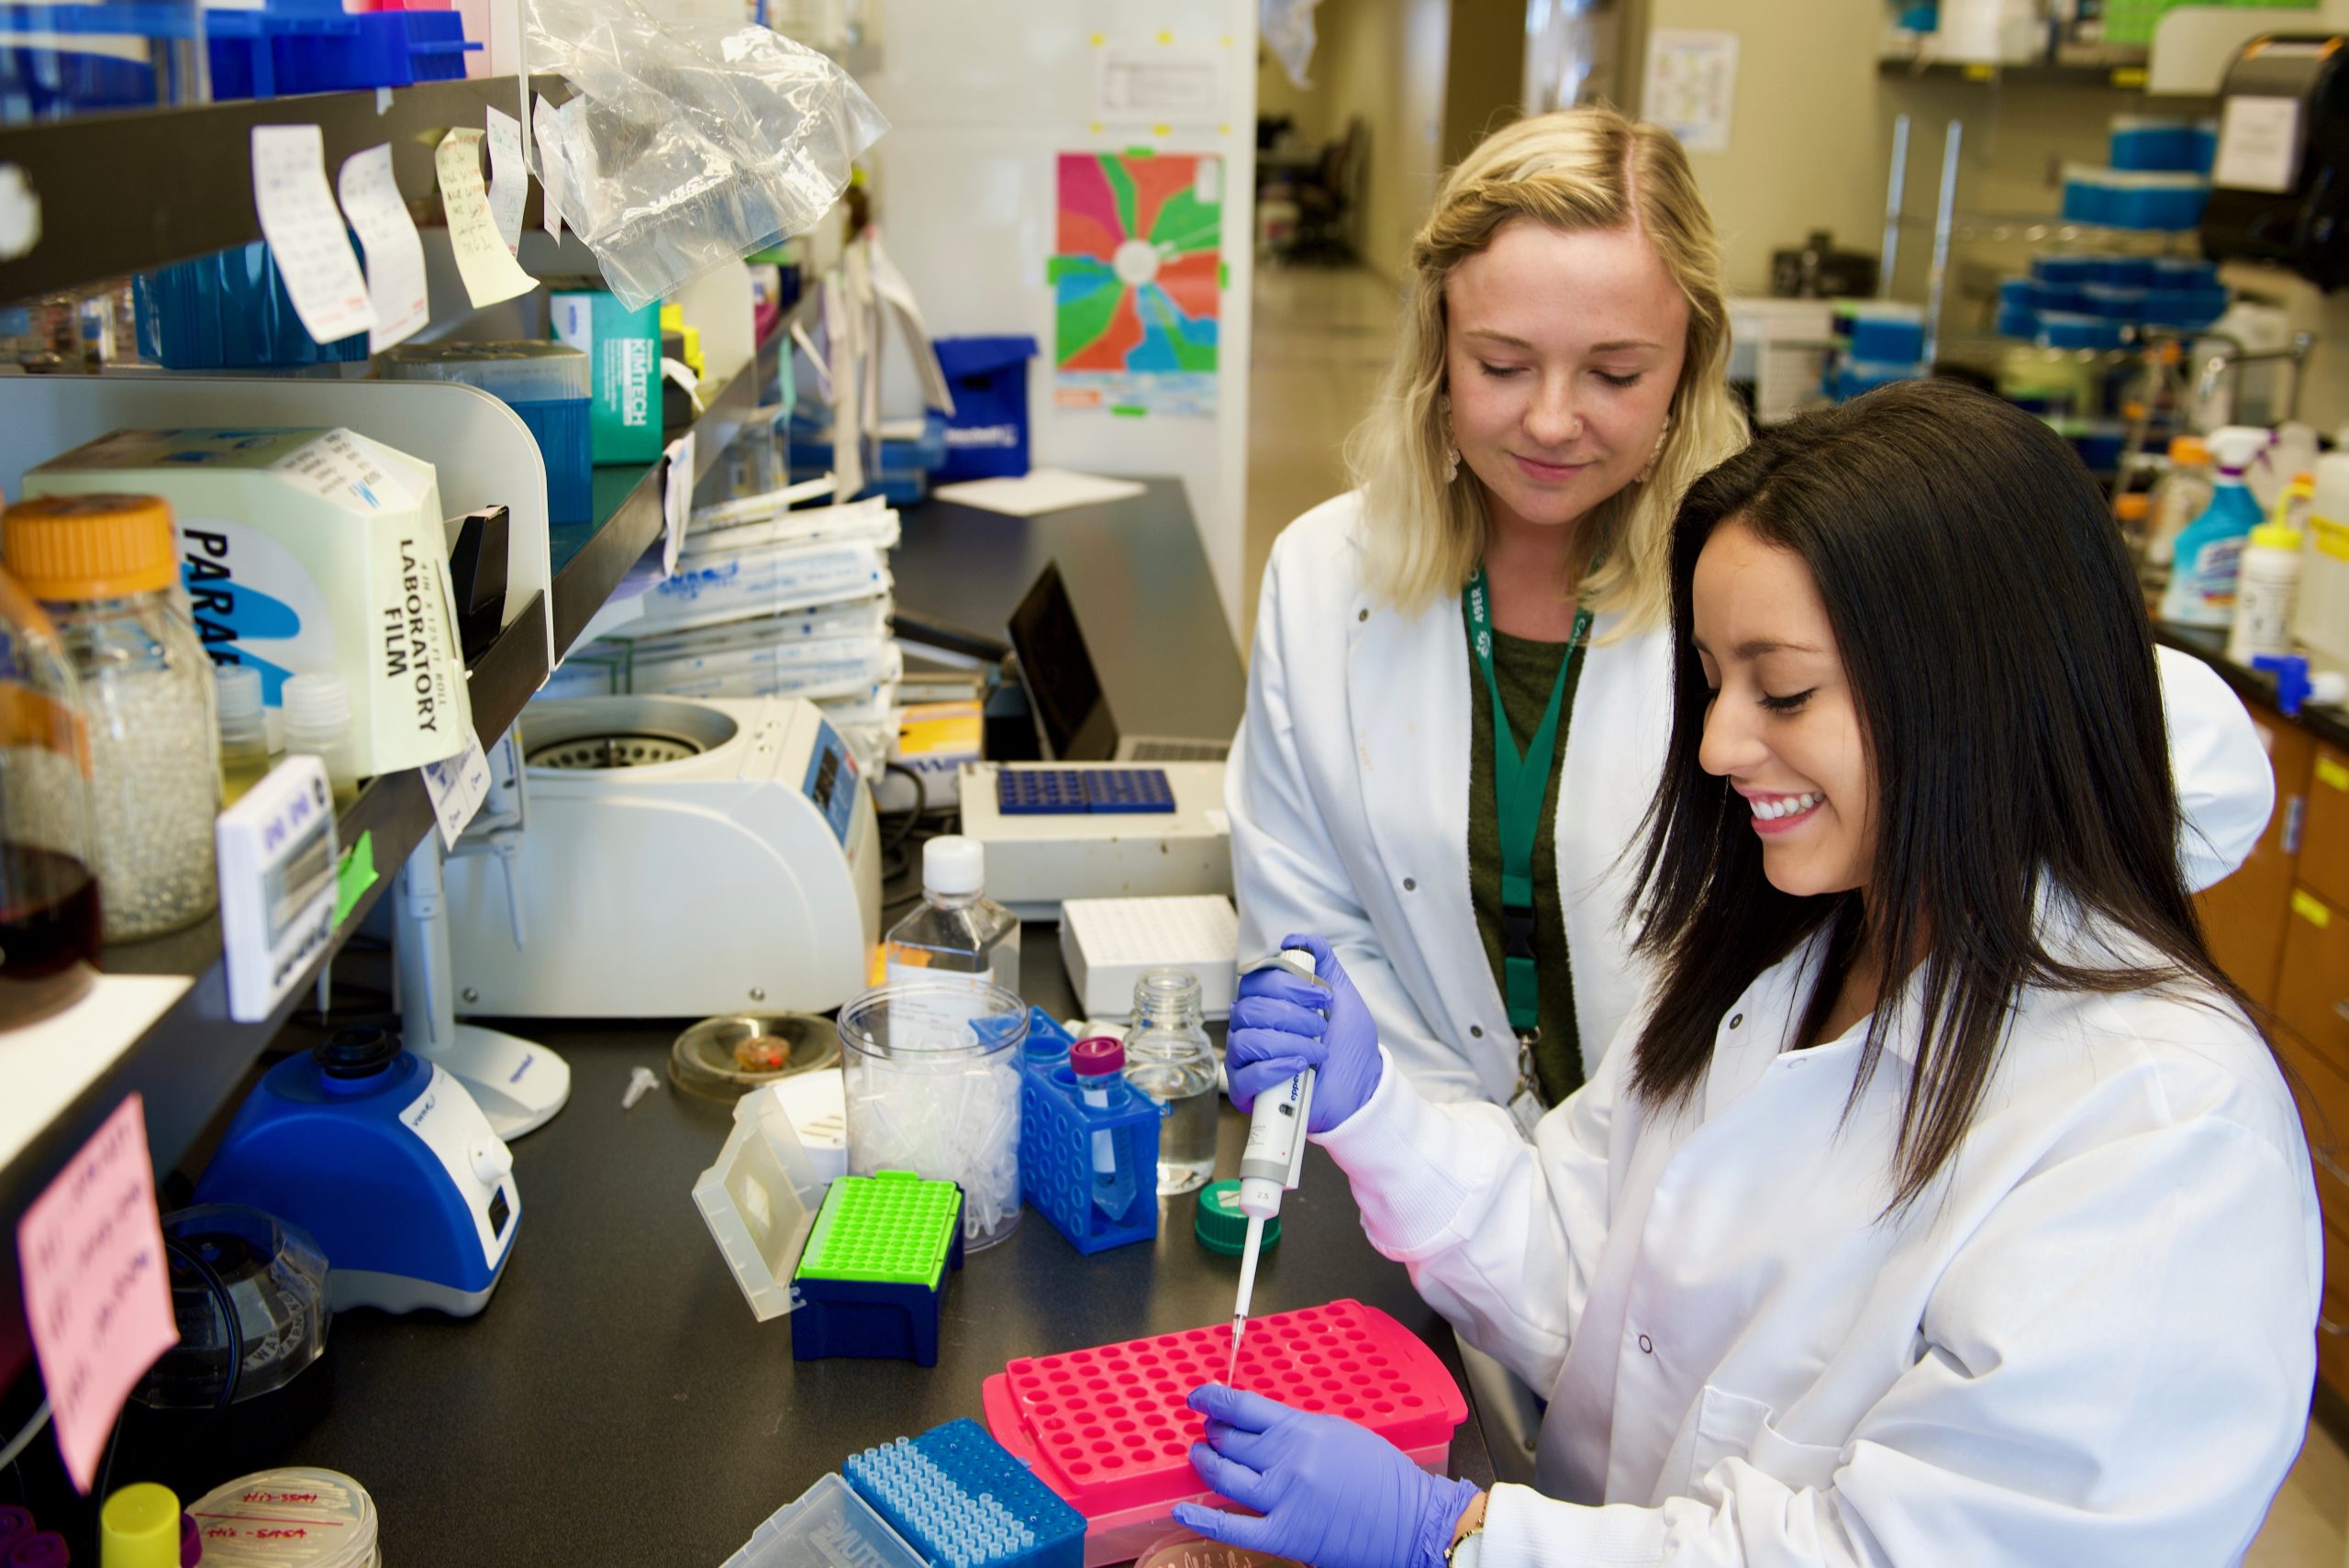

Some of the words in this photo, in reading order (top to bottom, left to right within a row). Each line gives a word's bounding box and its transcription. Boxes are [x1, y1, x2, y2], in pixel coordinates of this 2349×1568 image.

[631, 338, 647, 426] KIMTECH
[1470, 586, 1484, 623] 49ER
[384, 606, 407, 678] FILM
[400, 539, 438, 733] LABORATORY
[412, 1102, 433, 1127] VWR
[1290, 1074, 1299, 1102] eppe
